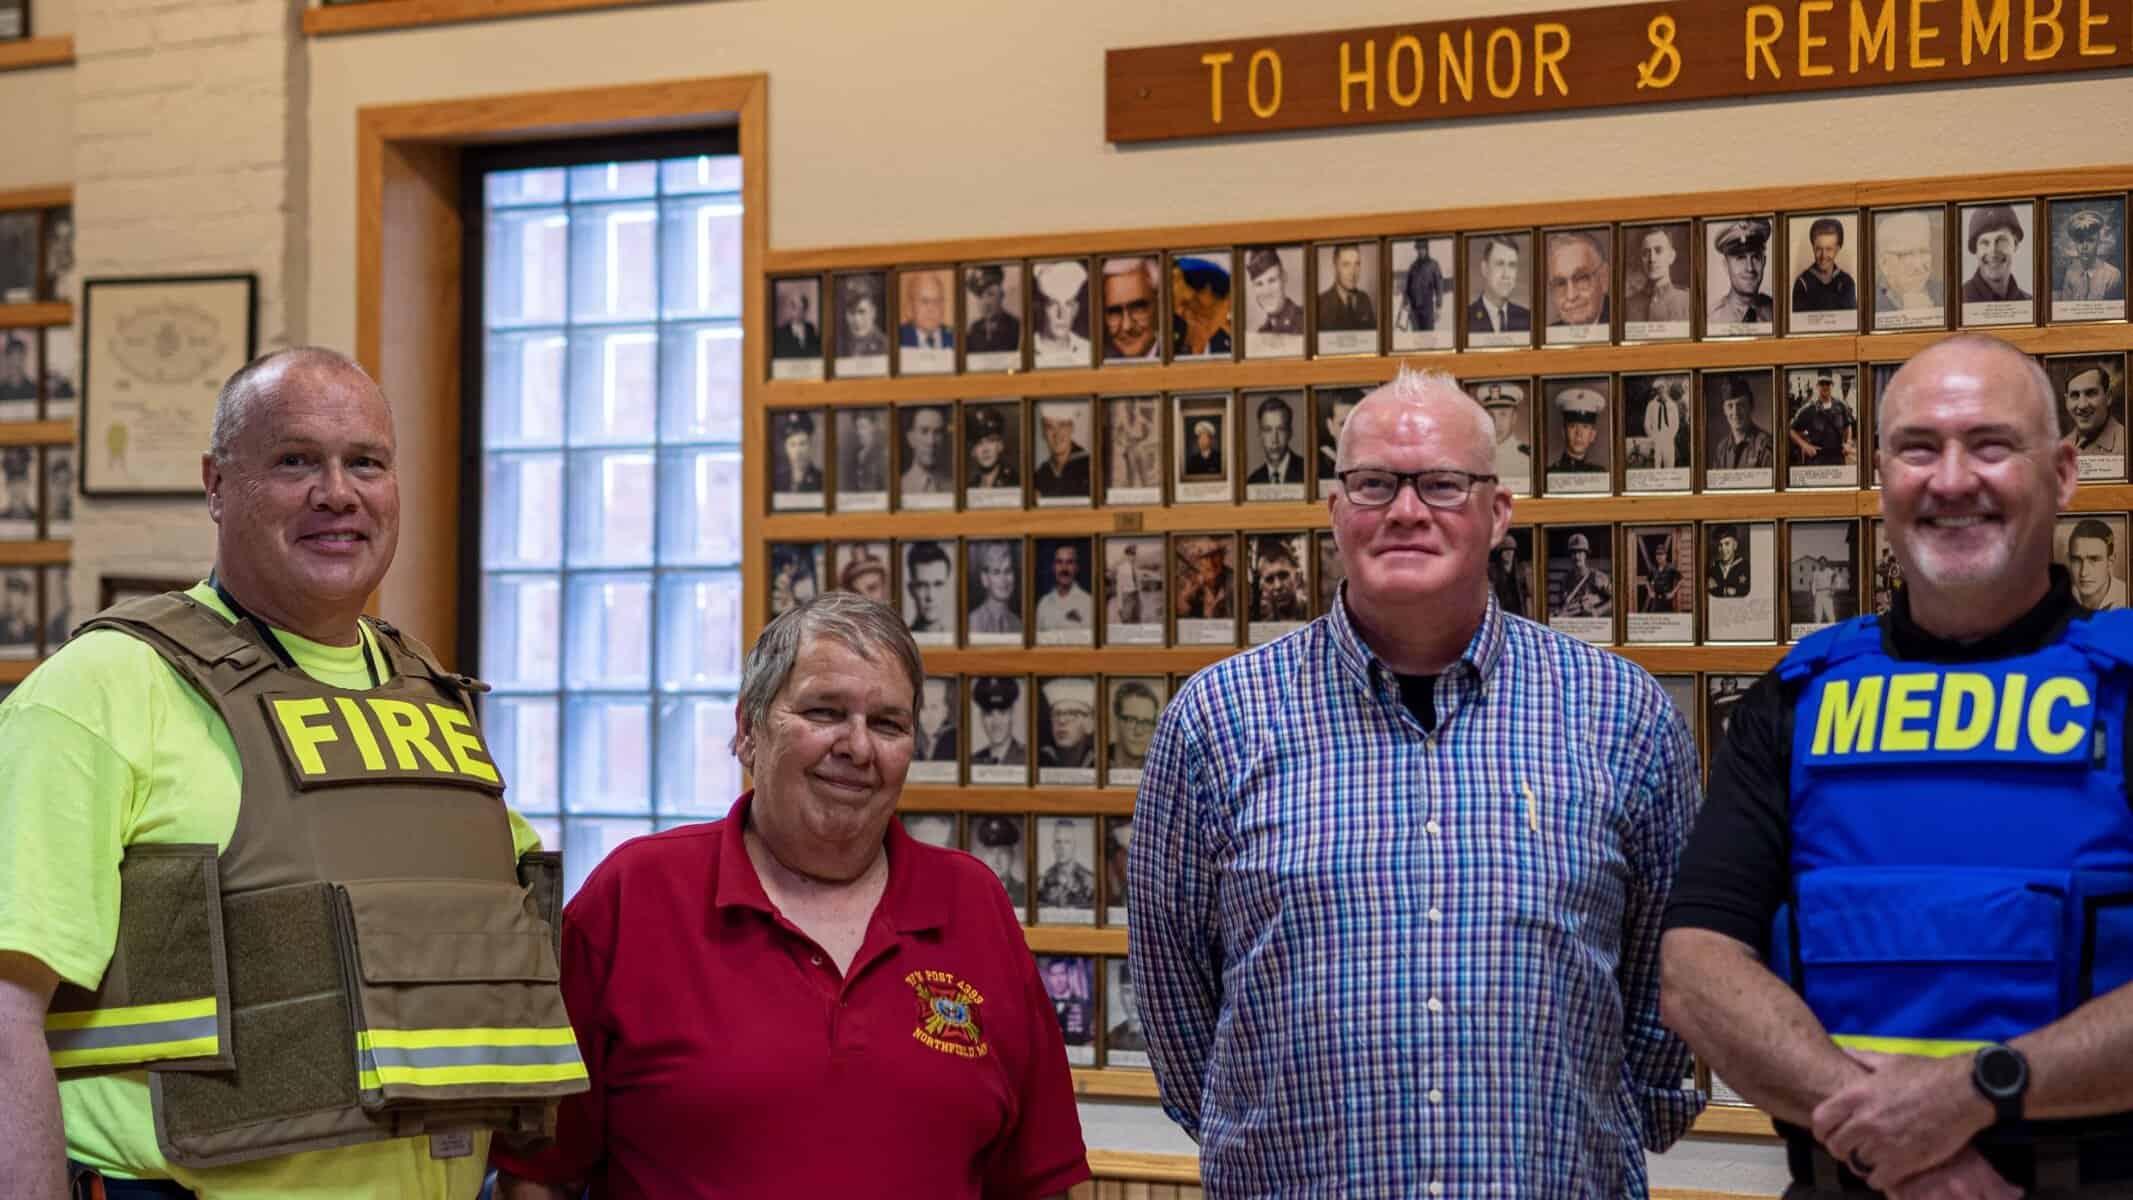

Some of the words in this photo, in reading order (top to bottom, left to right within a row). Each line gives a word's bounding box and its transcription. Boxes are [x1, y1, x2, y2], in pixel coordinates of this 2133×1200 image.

[1201, 49, 1282, 124] TO
[1340, 23, 1570, 113] HONOR
[1636, 15, 1682, 89] &
[1745, 0, 2133, 81] REMEMBE
[272, 696, 500, 784] FIRE
[1811, 672, 2090, 755] MEDIC
[925, 970, 954, 984] POST
